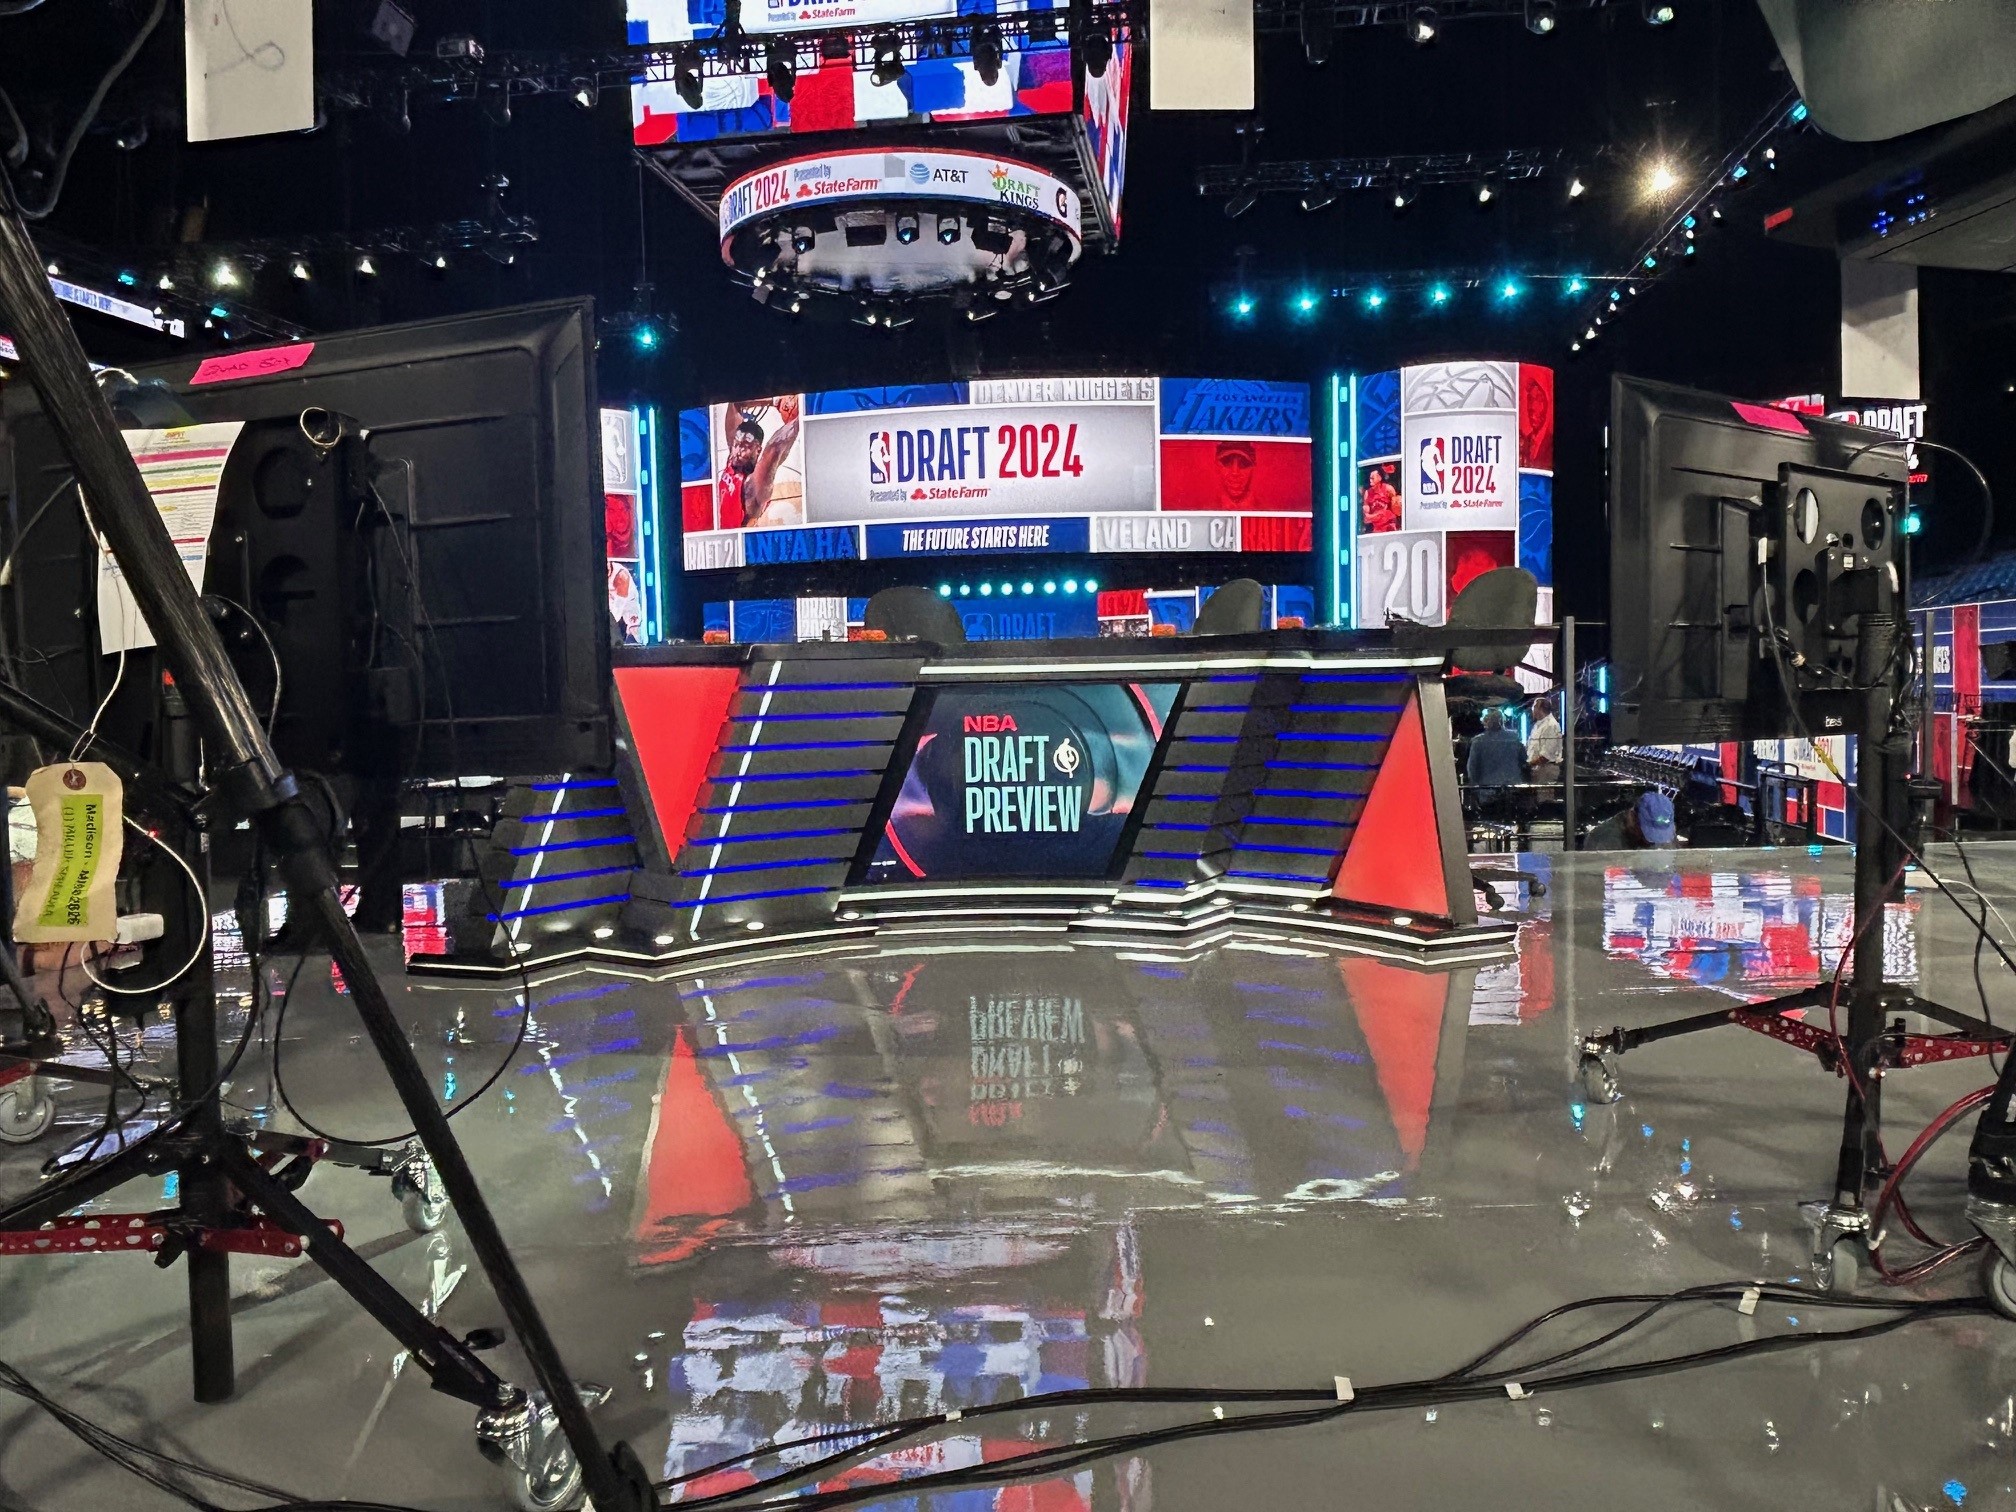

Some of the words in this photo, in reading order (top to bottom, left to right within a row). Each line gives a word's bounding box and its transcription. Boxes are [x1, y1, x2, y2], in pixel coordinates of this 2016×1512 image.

[933, 168, 969, 183] AT&T
[993, 177, 1041, 197] DRAFT
[755, 170, 790, 210] 2024
[1000, 189, 1039, 210] KINGS
[976, 382, 1053, 404] DENVER
[1061, 379, 1155, 401] NUGGETS
[897, 426, 990, 482] DRAFT
[998, 423, 1084, 478] 2024
[1451, 435, 1502, 464] DRAFT
[1451, 465, 1496, 494] 2024
[870, 489, 898, 501] Presented
[902, 529, 925, 551] THE
[925, 527, 970, 550] FUTURE
[970, 525, 1017, 549] STARTS
[1018, 525, 1050, 547] HERE
[963, 714, 1018, 733] NBA
[964, 735, 1050, 783] DRAFT
[965, 785, 1083, 833] PREVIEW
